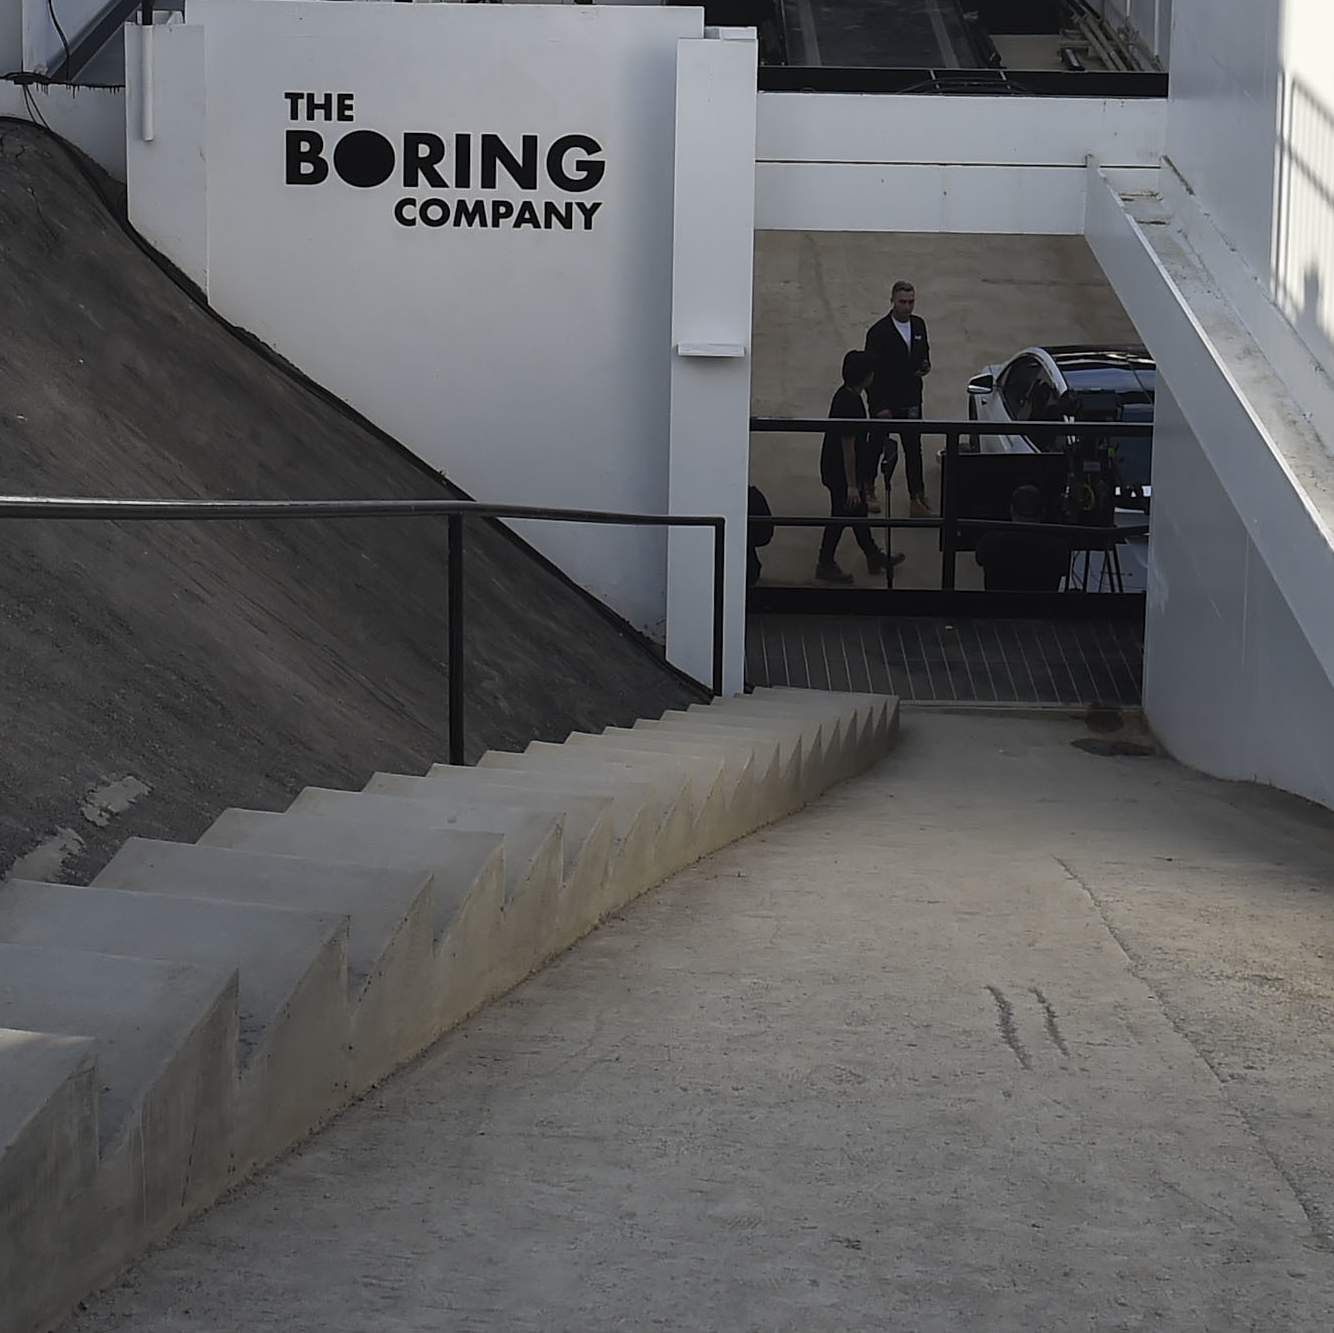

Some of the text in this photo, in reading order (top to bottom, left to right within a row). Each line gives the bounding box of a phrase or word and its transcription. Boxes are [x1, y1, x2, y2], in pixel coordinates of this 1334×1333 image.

[284, 91, 355, 122] THE
[284, 129, 607, 194] BORING
[394, 197, 603, 231] COMPANY
